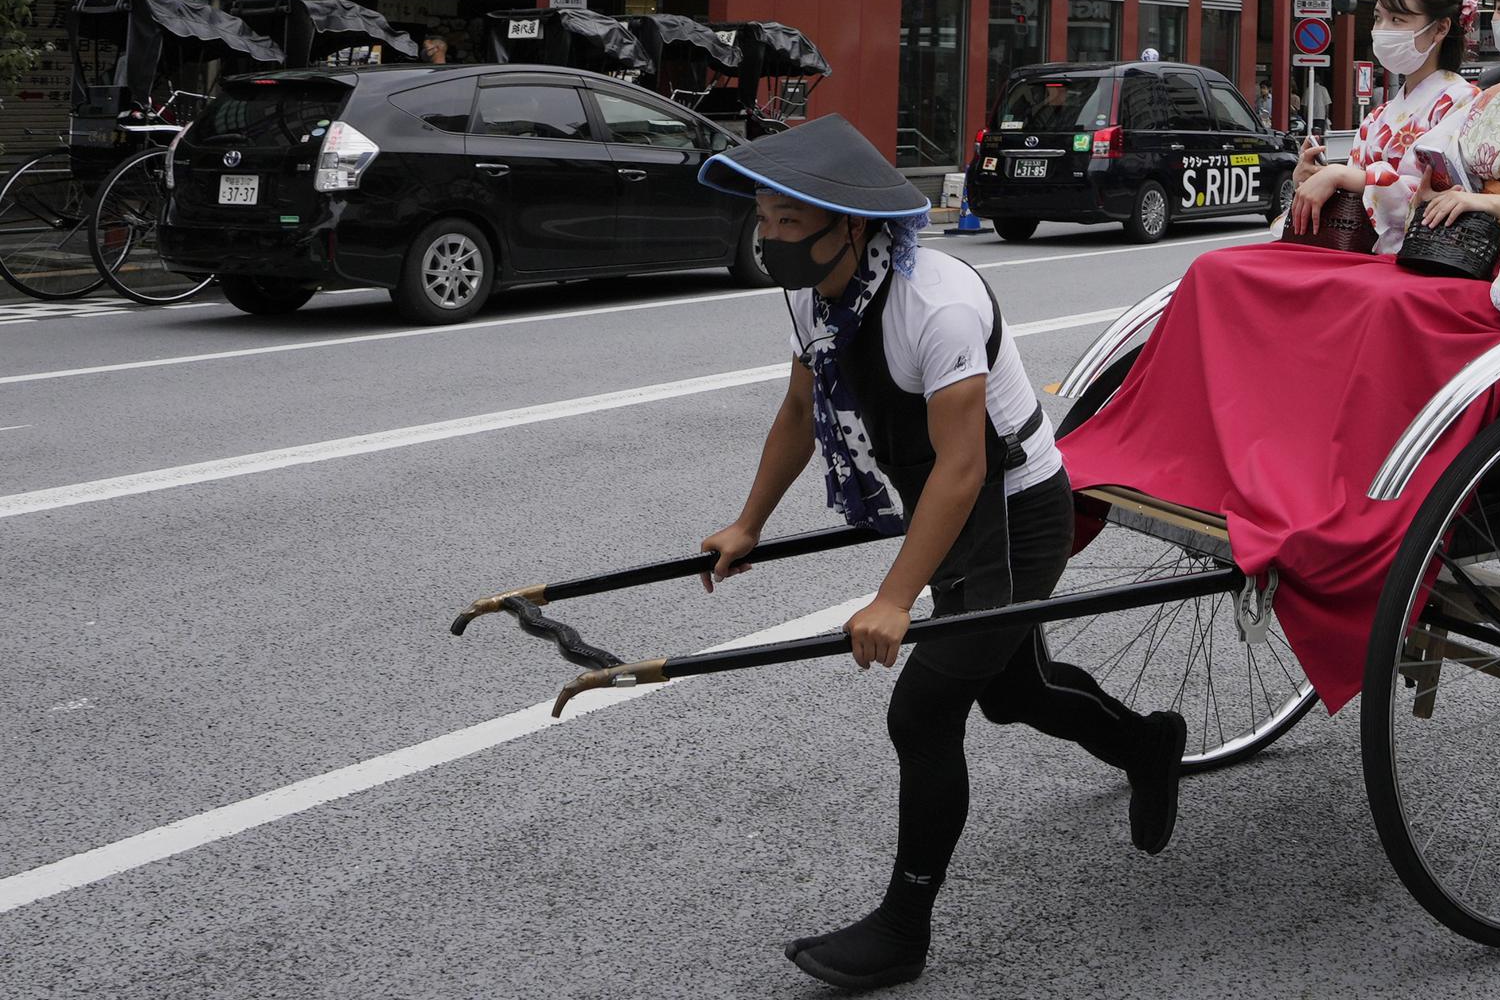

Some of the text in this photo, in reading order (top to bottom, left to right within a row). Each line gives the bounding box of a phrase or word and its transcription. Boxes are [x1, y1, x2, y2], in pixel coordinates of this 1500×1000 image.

[1182, 155, 1229, 168] タクシーアプリ
[1021, 166, 1045, 176] 31-85
[1181, 165, 1262, 208] S.RIDE
